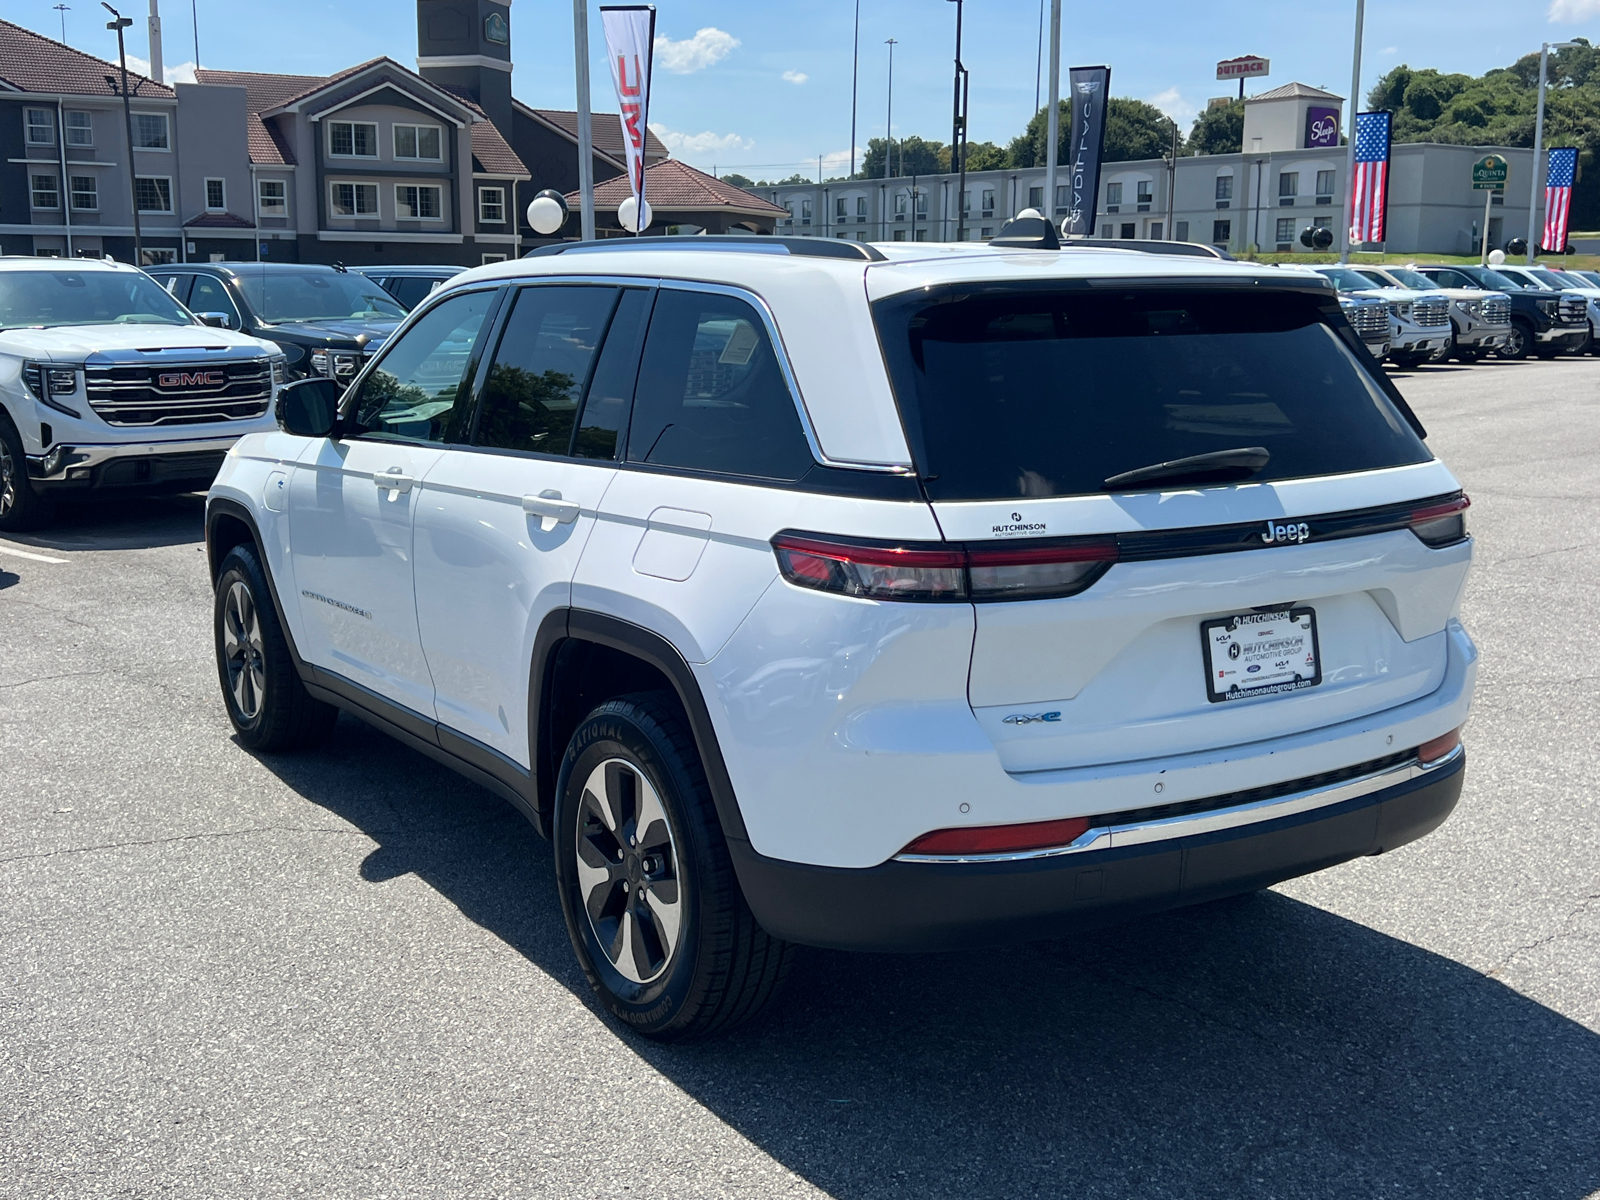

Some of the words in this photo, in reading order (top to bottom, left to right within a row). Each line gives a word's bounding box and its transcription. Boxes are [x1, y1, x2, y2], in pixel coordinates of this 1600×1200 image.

[1216, 62, 1263, 75] OUTBACK
[1311, 120, 1334, 140] Sleep
[1479, 169, 1505, 178] QUINTA
[159, 371, 223, 387] GMC
[992, 523, 1046, 532] HUTCHINSON
[1261, 521, 1310, 544] Jeep
[1242, 611, 1291, 625] HUTCHINSON
[1243, 636, 1304, 655] HUTCHINSON
[1244, 650, 1282, 662] AUTOMOTIVE
[1283, 647, 1302, 656] GROUP
[1225, 680, 1311, 700] Hutchinsonautogroup.com
[569, 722, 623, 762] NATIONAL
[629, 995, 673, 1024] COMMANDO
